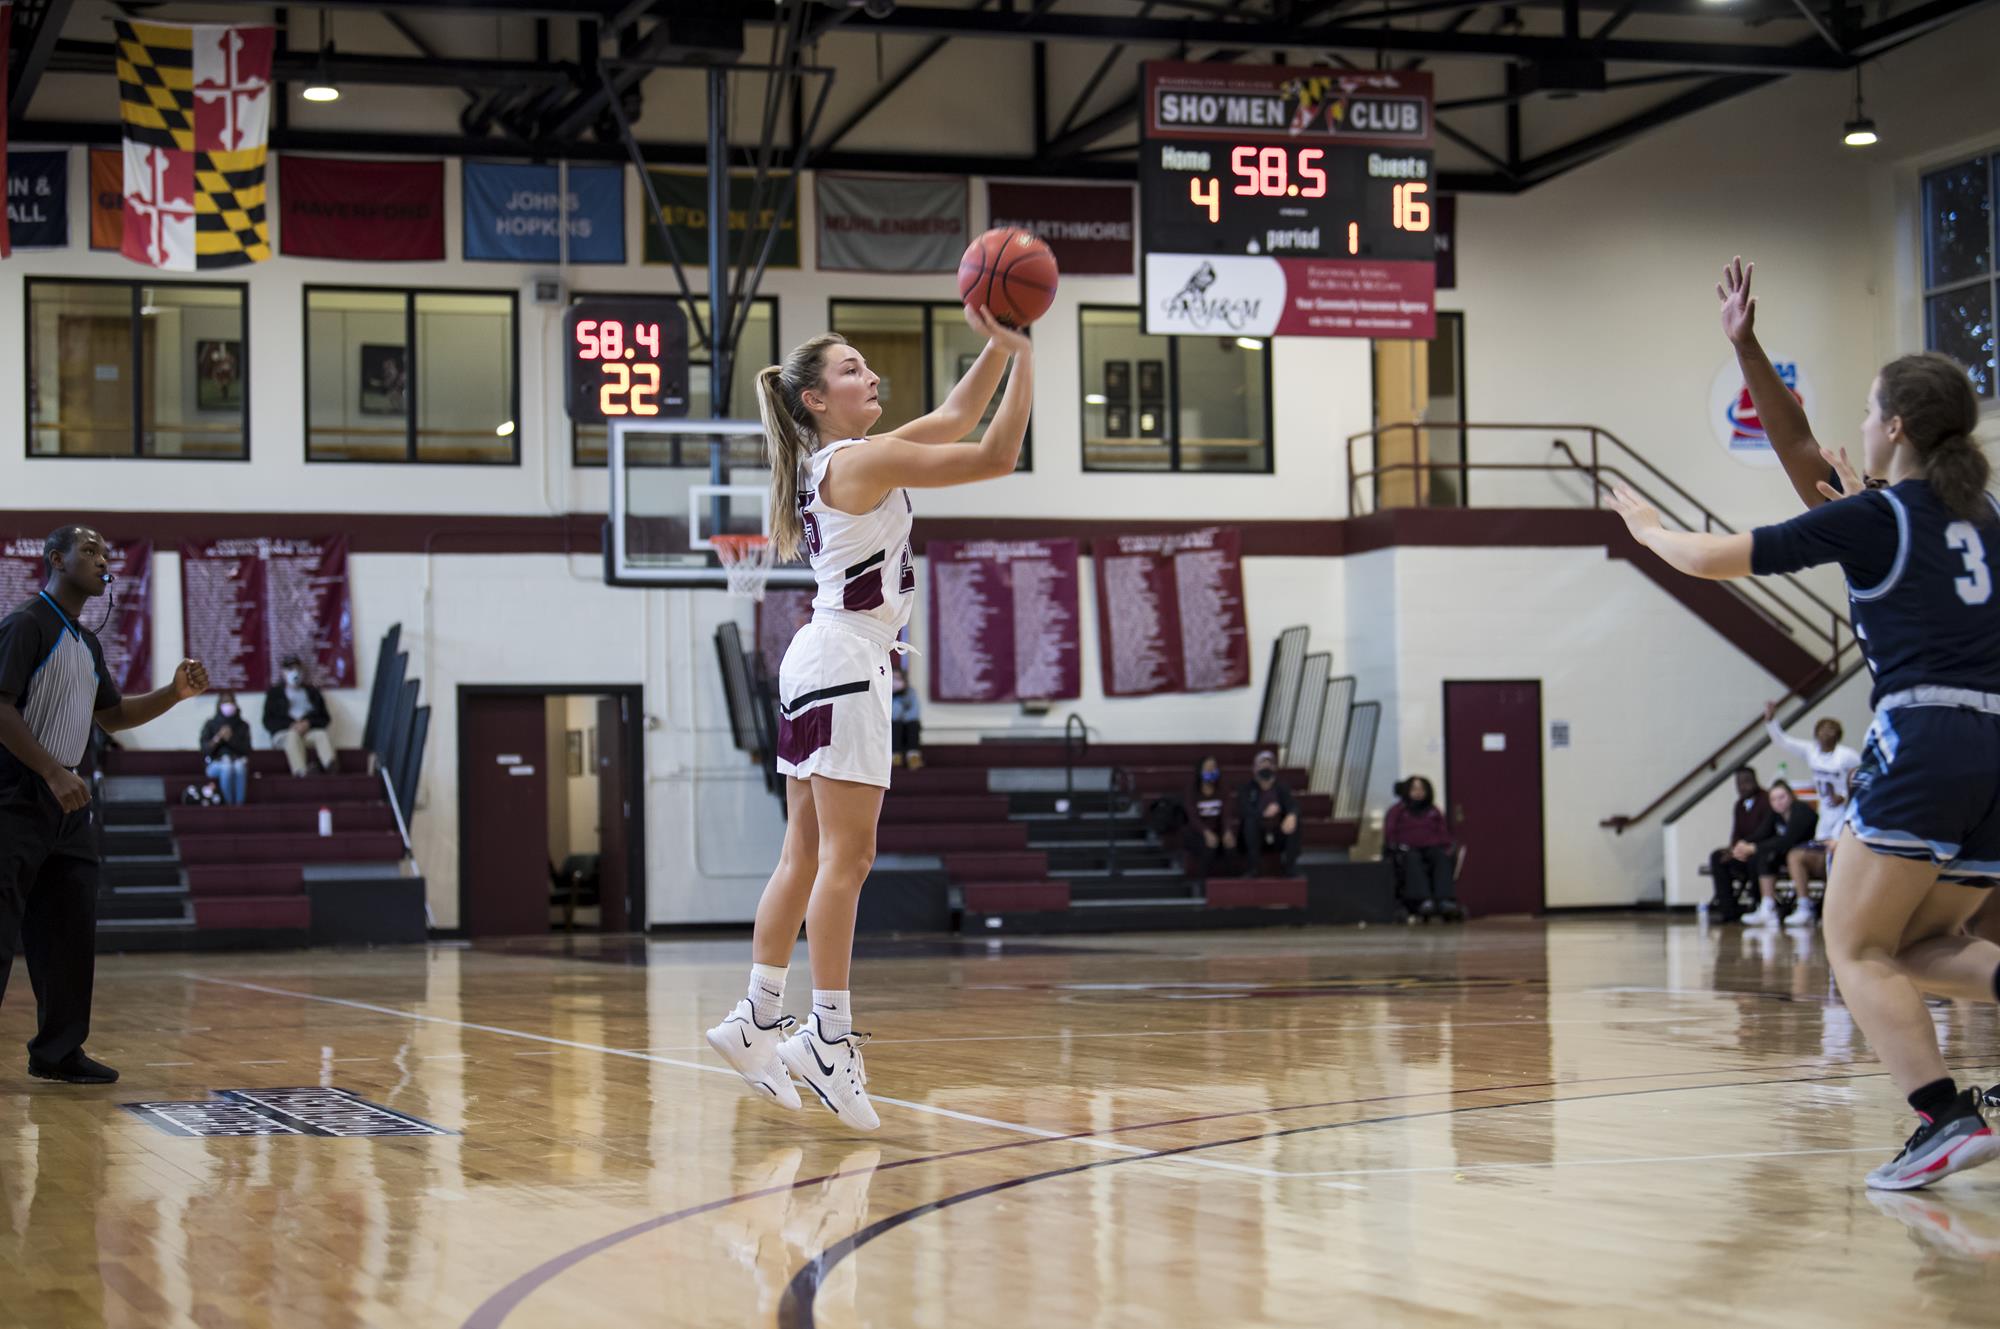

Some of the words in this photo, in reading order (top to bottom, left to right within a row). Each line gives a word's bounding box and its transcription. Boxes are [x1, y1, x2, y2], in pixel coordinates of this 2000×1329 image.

[1161, 94, 1285, 126] SHO'MEN
[1351, 102, 1419, 131] CLUB
[1161, 146, 1211, 171] Home
[1232, 146, 1326, 198] 58.5
[1368, 152, 1428, 179] Guests
[35, 176, 51, 197] &
[1190, 177, 1220, 223] 4
[1393, 182, 1430, 232] 16
[495, 217, 593, 238] HOPKNS
[1266, 226, 1320, 253] period
[1348, 222, 1359, 255] 1
[577, 320, 660, 360] 58.4
[600, 362, 661, 415] 22
[1945, 520, 1993, 606] 3
